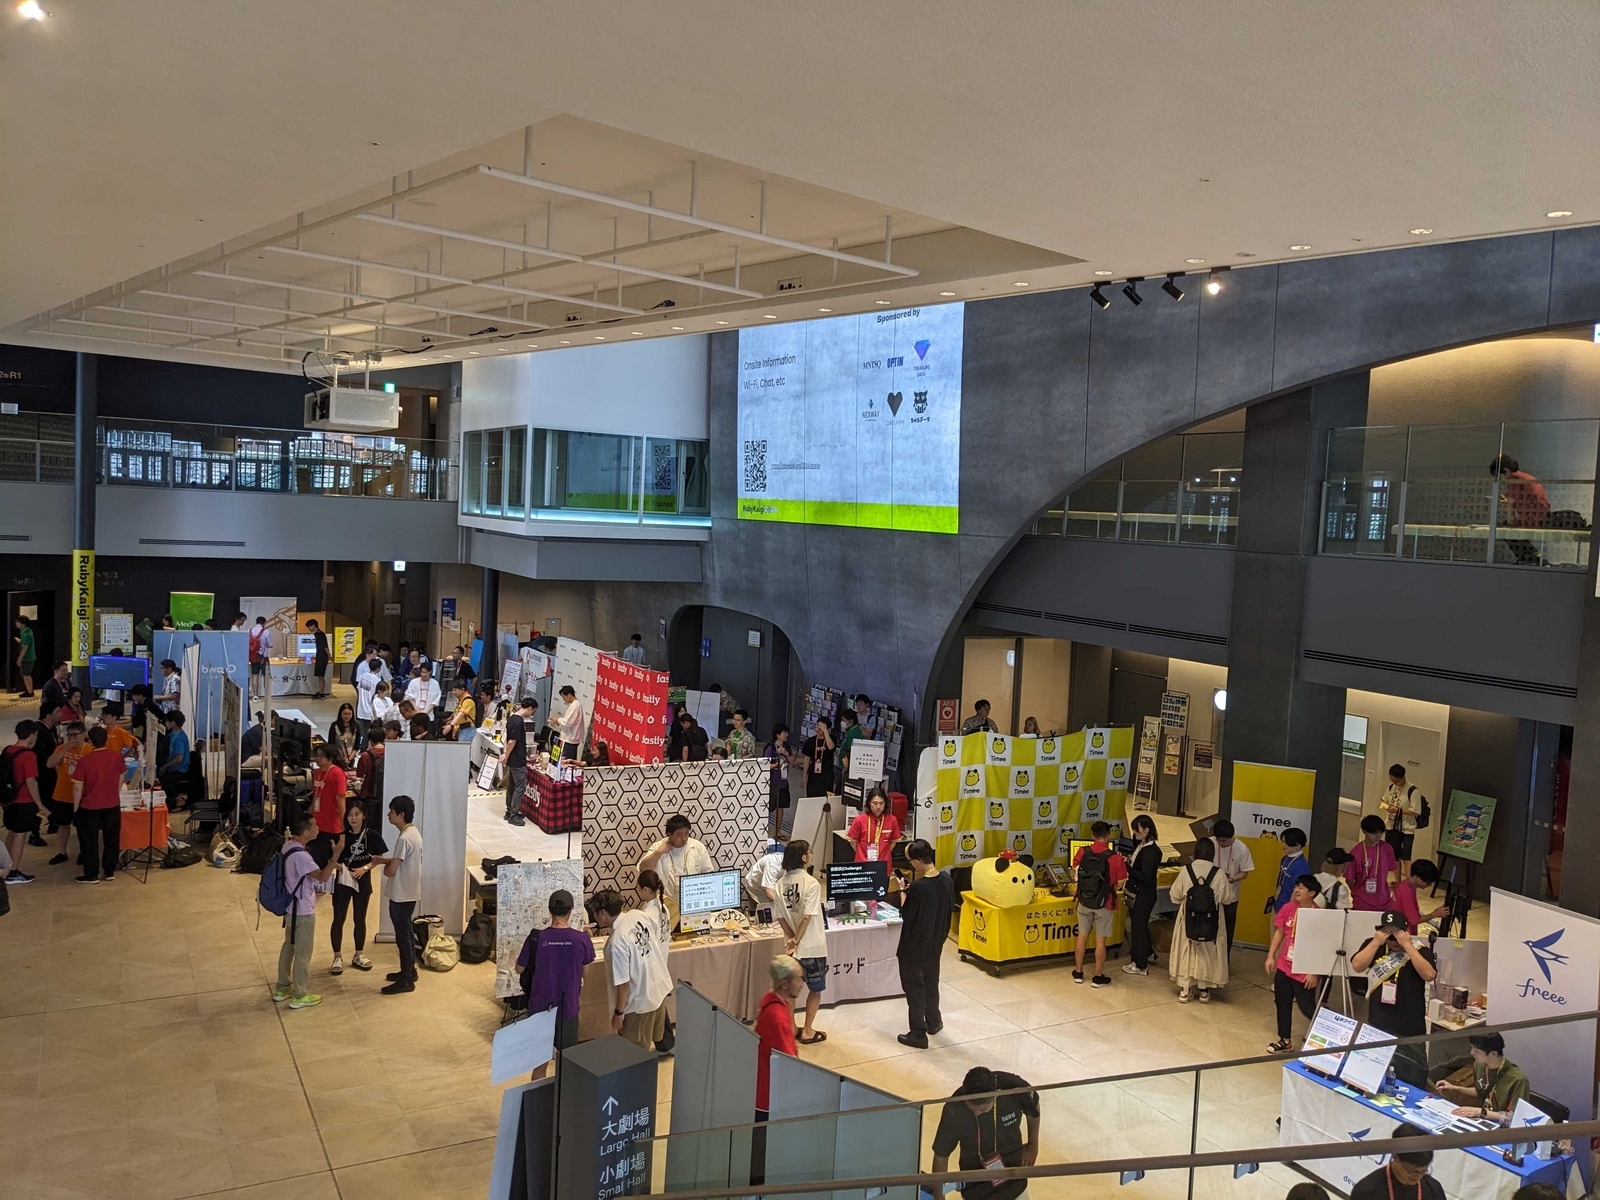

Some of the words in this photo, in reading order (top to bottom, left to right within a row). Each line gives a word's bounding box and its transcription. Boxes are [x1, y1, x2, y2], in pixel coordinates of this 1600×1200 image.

[877, 309, 911, 324] Sponsored
[912, 307, 921, 317] by
[744, 361, 761, 370] Onsite
[762, 354, 796, 367] Information
[744, 379, 759, 390] Wi-Fi,
[760, 378, 775, 388] Chat,
[776, 377, 785, 386] etc
[862, 411, 880, 419] NEXWAY
[743, 505, 764, 514] RubyKaigi
[77, 556, 90, 620] RubyKaigi
[282, 675, 308, 683] 食べログ
[642, 735, 665, 747] fastly
[1252, 813, 1292, 828] Timee
[1387, 914, 1393, 922] S
[1042, 922, 1092, 941] Time
[1516, 978, 1567, 1005] freee
[602, 1107, 650, 1141] 大劇場
[632, 1127, 650, 1140] Hall
[600, 1151, 646, 1185] 小劇場
[628, 1172, 646, 1189] Hall
